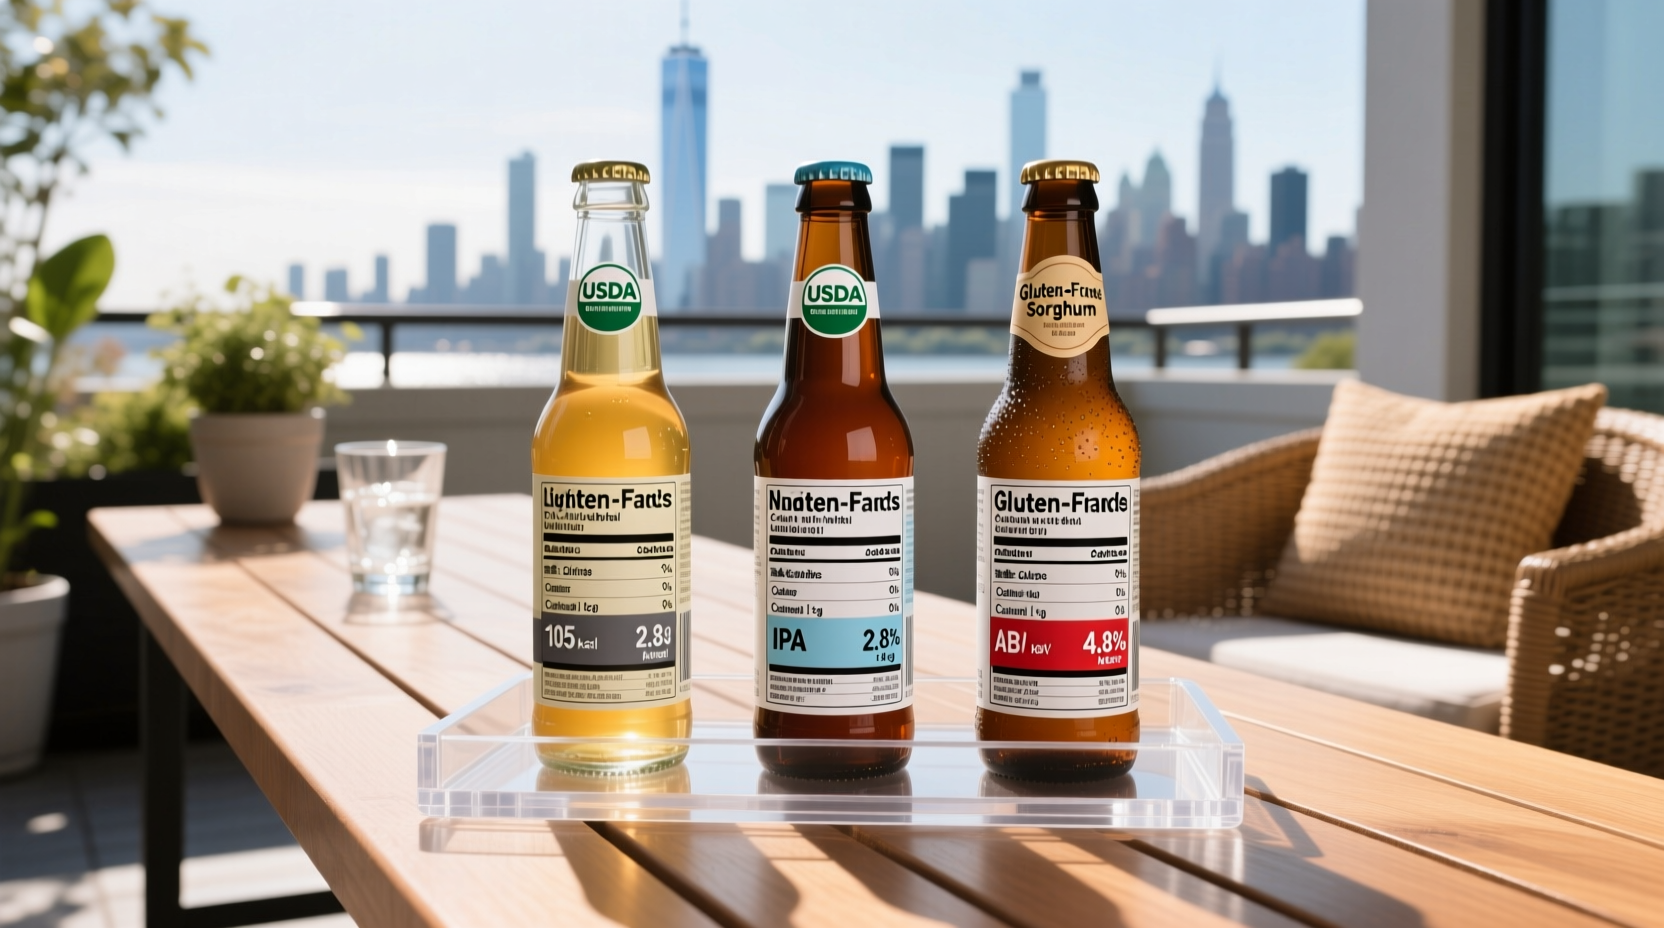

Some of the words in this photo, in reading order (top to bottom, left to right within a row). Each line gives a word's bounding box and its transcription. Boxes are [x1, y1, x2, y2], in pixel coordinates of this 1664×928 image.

[582, 281, 637, 300] USDA
[807, 284, 863, 303] USDA
[1026, 300, 1097, 321] Sorghum
[544, 623, 576, 650] 105
[772, 627, 807, 652] IPA
[1082, 630, 1127, 655] 4.8%
